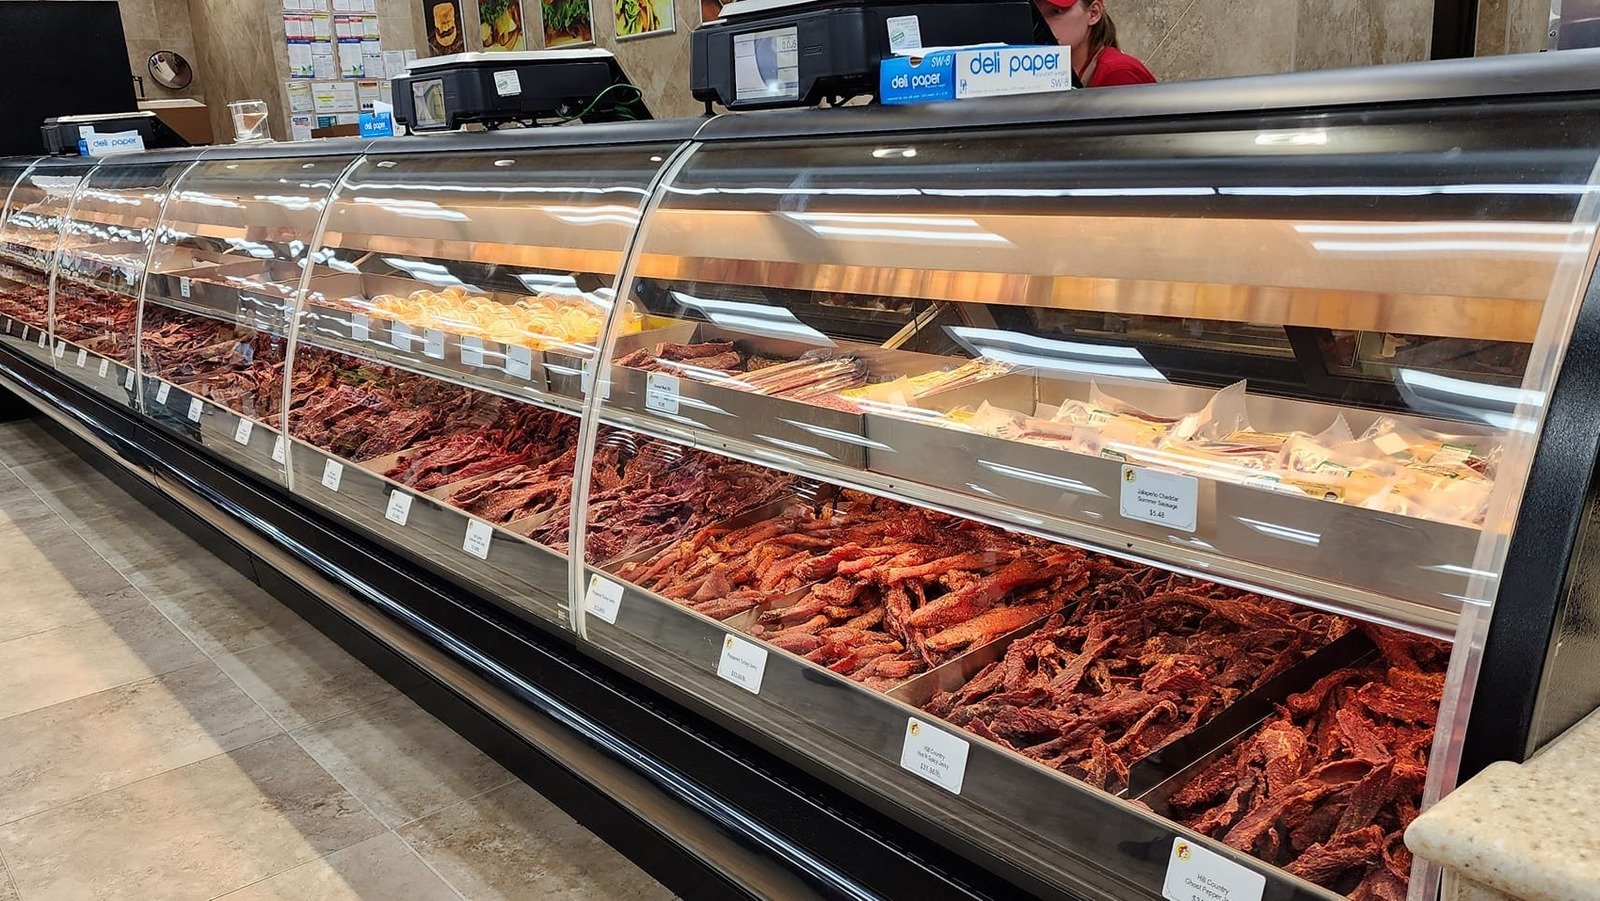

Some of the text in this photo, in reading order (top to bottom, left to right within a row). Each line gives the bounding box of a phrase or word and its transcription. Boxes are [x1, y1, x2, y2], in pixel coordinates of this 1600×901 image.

[931, 55, 951, 68] SW-8
[970, 51, 1060, 77] deli paper
[891, 73, 941, 90] deli paper
[1050, 77, 1070, 88] SW-8
[93, 138, 136, 148] deli paper
[1159, 492, 1179, 502] Cheddar
[1184, 877, 1202, 891] Ghost
[1202, 885, 1223, 900] Pepper
[1197, 874, 1230, 895] Hill Country
